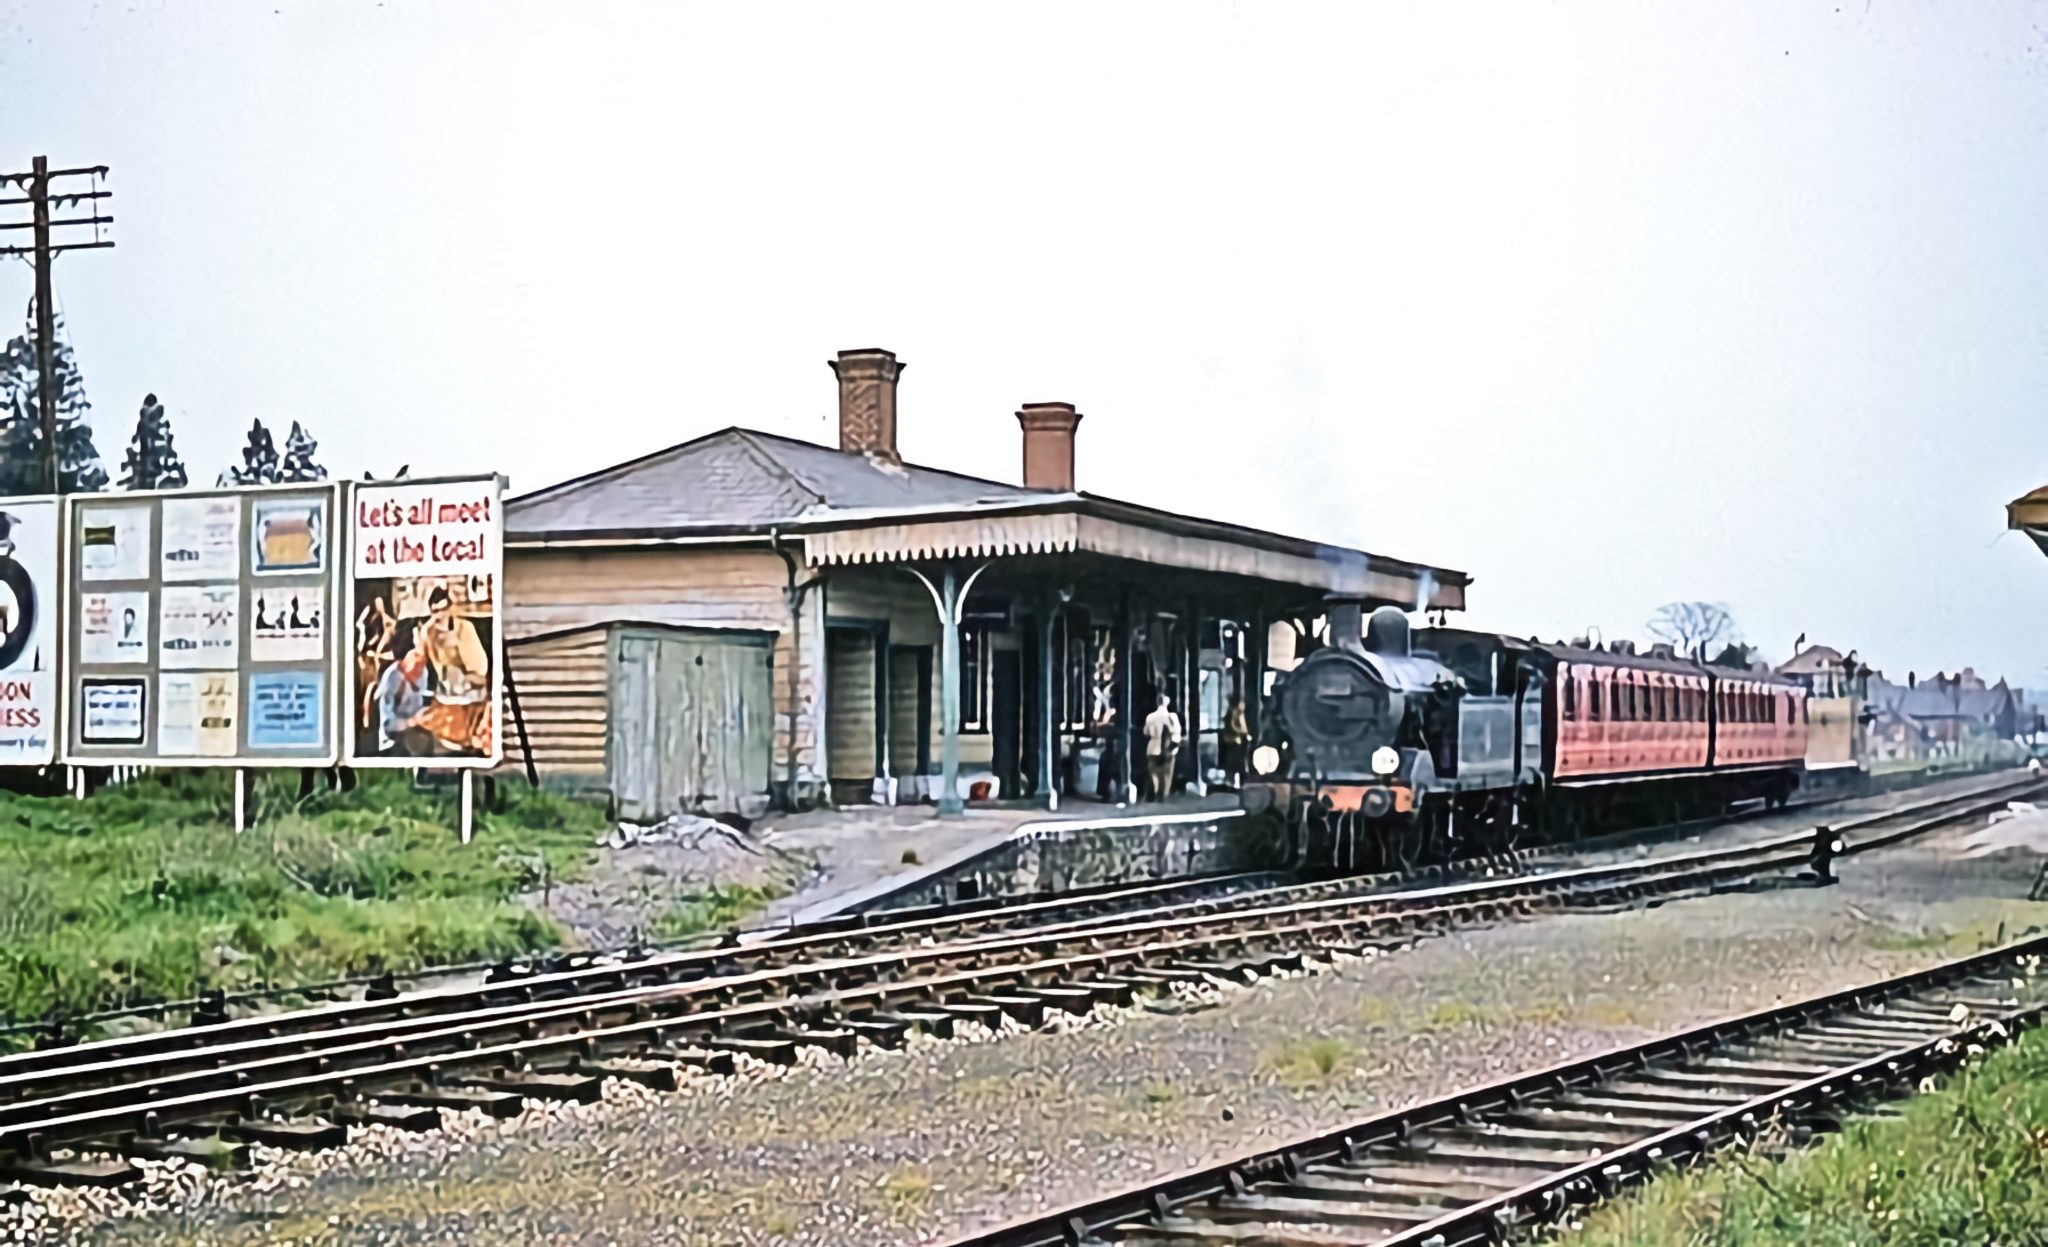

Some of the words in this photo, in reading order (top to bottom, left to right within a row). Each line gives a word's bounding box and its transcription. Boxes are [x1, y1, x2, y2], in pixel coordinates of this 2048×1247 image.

[360, 499, 402, 527] Let's
[408, 498, 432, 525] all
[439, 496, 490, 524] meet
[365, 538, 385, 564] at
[394, 536, 424, 563] the
[432, 533, 484, 561] Local
[0, 682, 31, 701] ON
